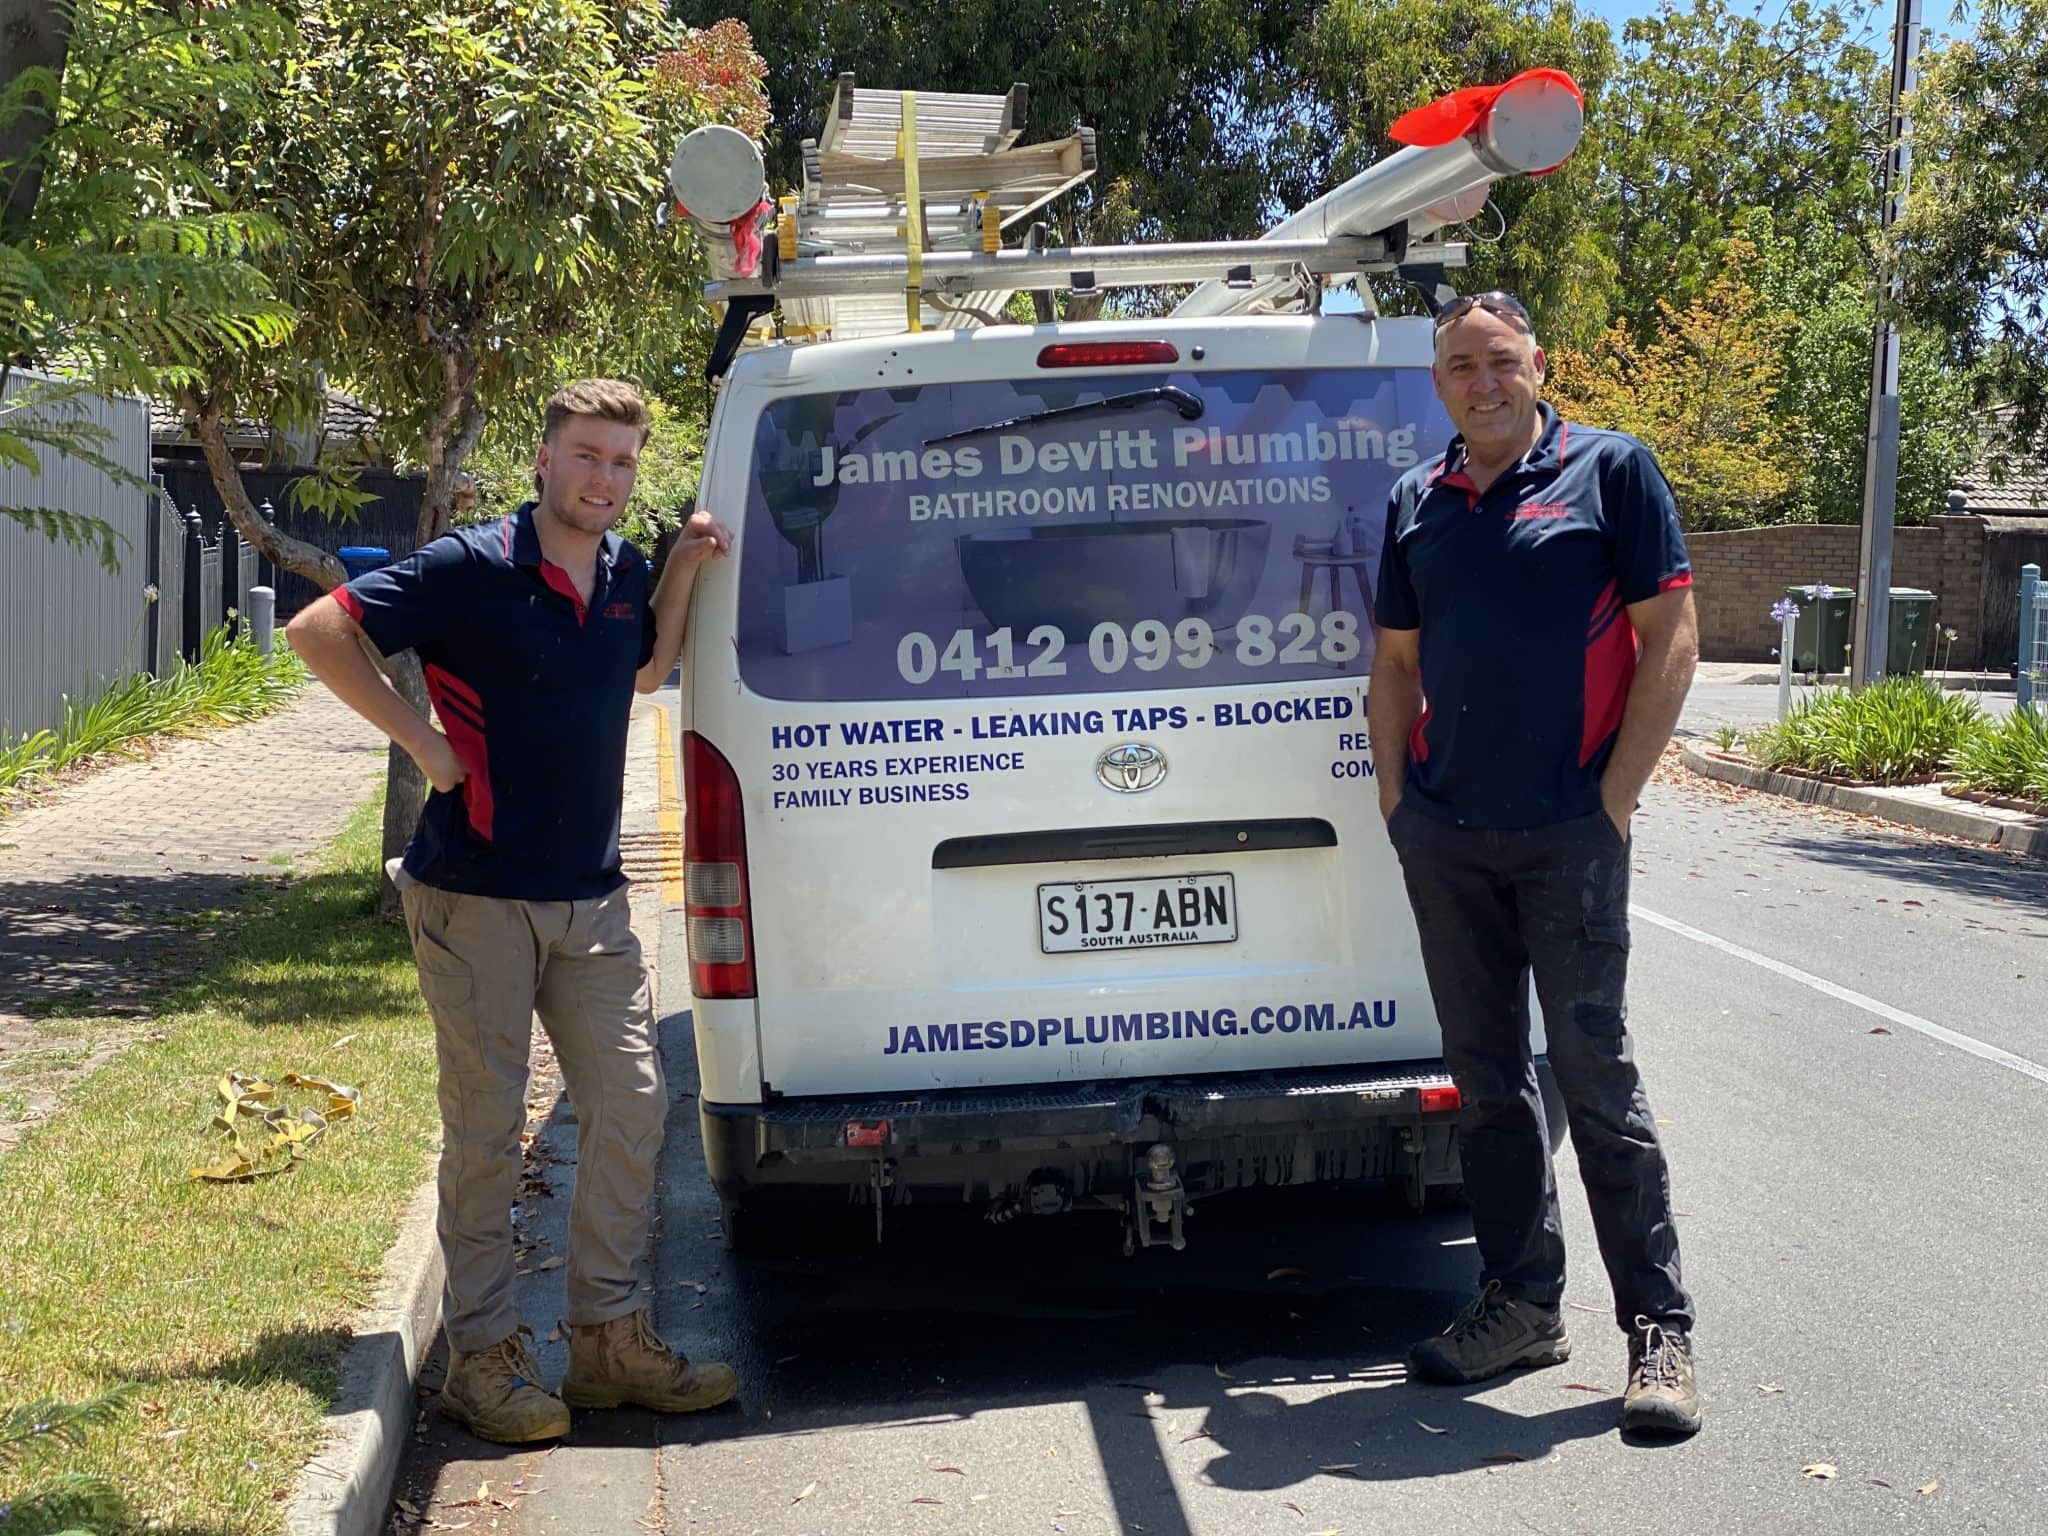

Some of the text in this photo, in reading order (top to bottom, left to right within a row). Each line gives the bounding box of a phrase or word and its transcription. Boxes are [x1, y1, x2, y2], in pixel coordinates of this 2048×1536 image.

[813, 422, 1419, 487] James Devitt Plumbing
[909, 476, 1332, 521] BATHROOM RENOVATIONS
[897, 610, 1361, 685] 0412 099 828
[771, 724, 831, 749] HOT
[840, 718, 944, 745] WATER
[971, 711, 1104, 739] LEAKING
[1112, 705, 1188, 732] TAPS
[1214, 696, 1353, 727] BLOCKED
[772, 752, 1025, 782] 30 YEARS EXPERIENCE
[773, 783, 970, 809] FAMILY BUSINESS
[1047, 886, 1228, 936] S137-ABN
[1081, 931, 1199, 948] SOUTH AUSTRALIA
[884, 1000, 1396, 1055] JAMESDPLUMBING.COM.AU
